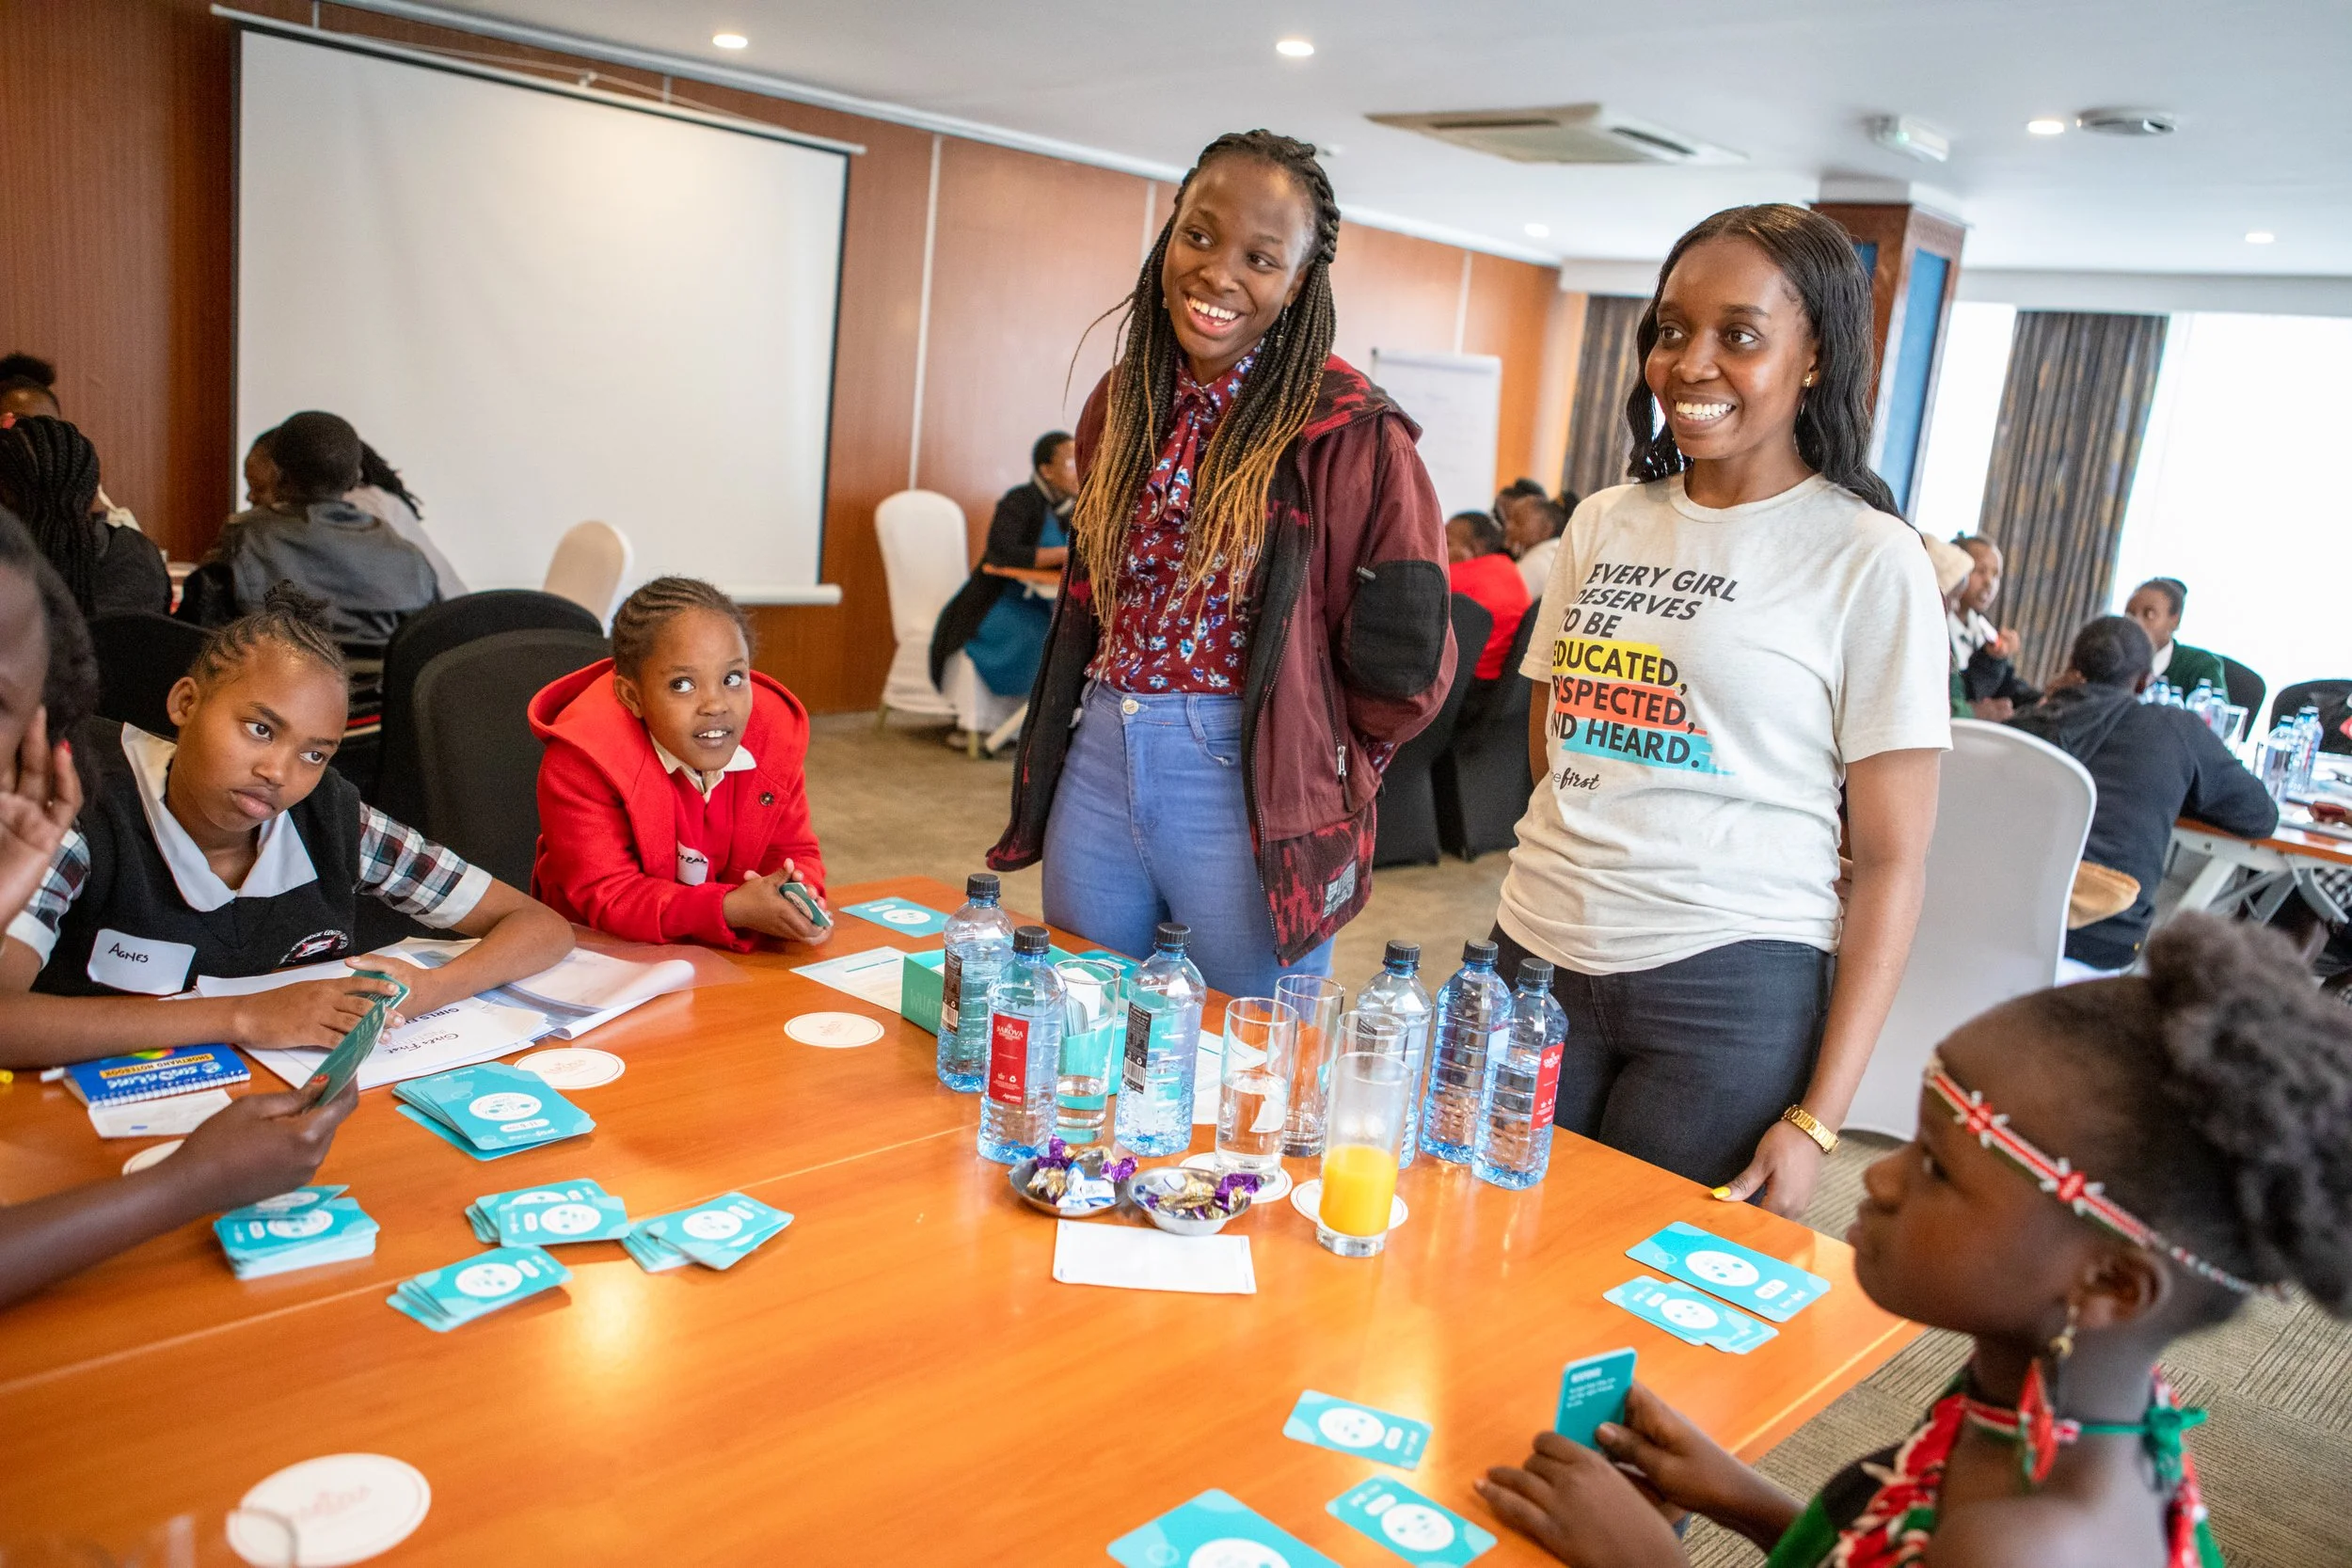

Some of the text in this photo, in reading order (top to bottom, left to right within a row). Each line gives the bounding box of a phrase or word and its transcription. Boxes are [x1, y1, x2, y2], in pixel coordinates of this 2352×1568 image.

[1585, 562, 1740, 602] EVERY GIRL
[1572, 588, 1703, 622] DESERVES
[1582, 611, 1623, 639] BE
[1551, 640, 1688, 696] EDUCATED,
[1551, 674, 1696, 735] RSPECTED,
[1550, 709, 1700, 768] ND HEARD.
[104, 1054, 211, 1077] SHORTHAND NOTEBOOK
